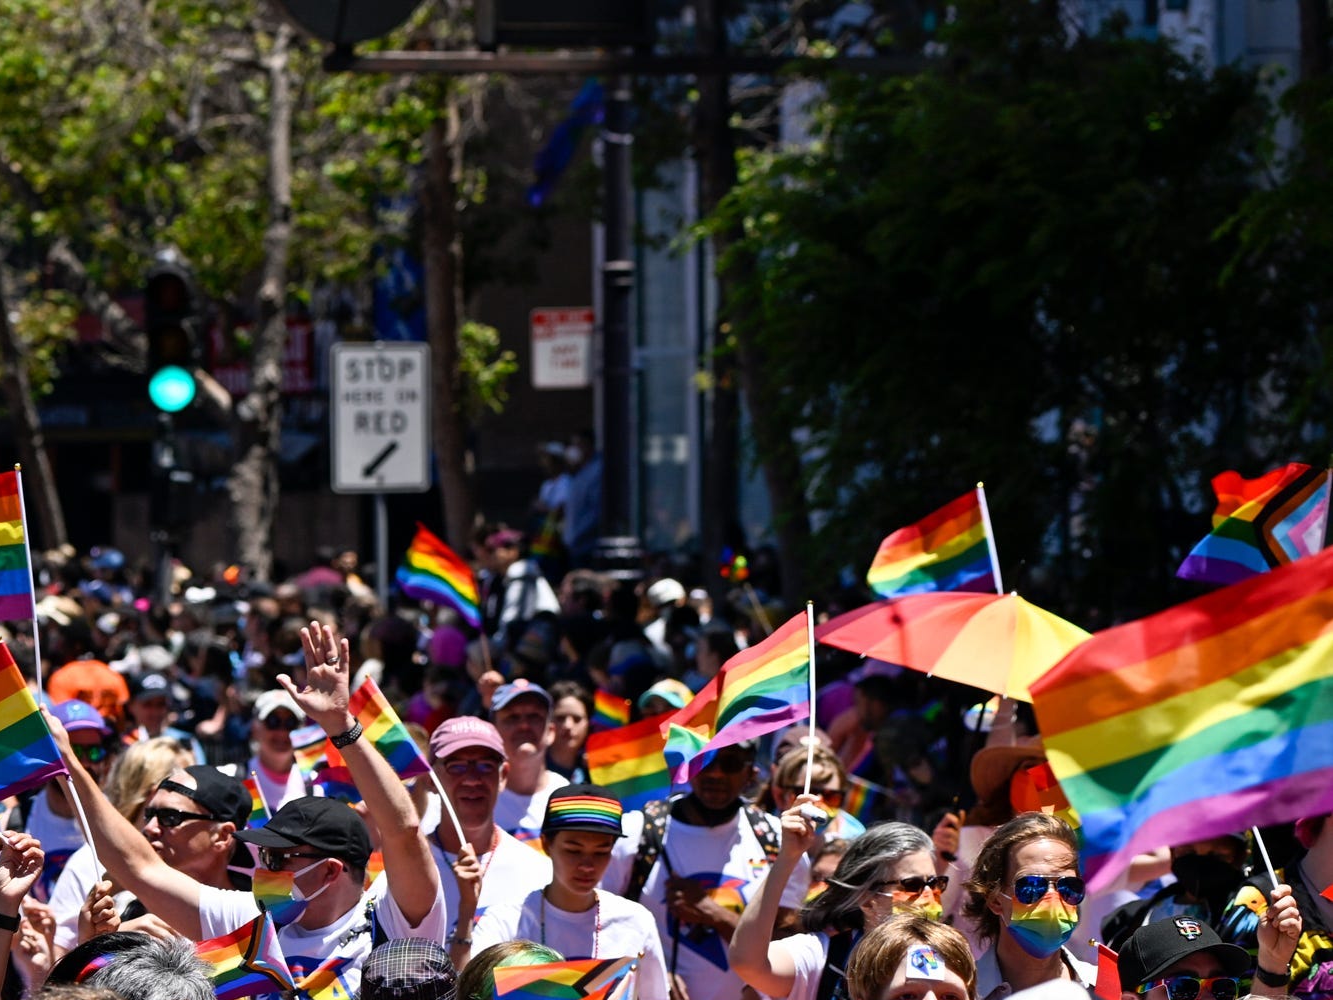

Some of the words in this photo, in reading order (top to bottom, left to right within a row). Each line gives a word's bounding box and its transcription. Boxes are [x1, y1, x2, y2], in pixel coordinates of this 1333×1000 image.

[345, 356, 416, 383] STOP
[342, 388, 383, 404] HERE
[353, 410, 408, 434] RED
